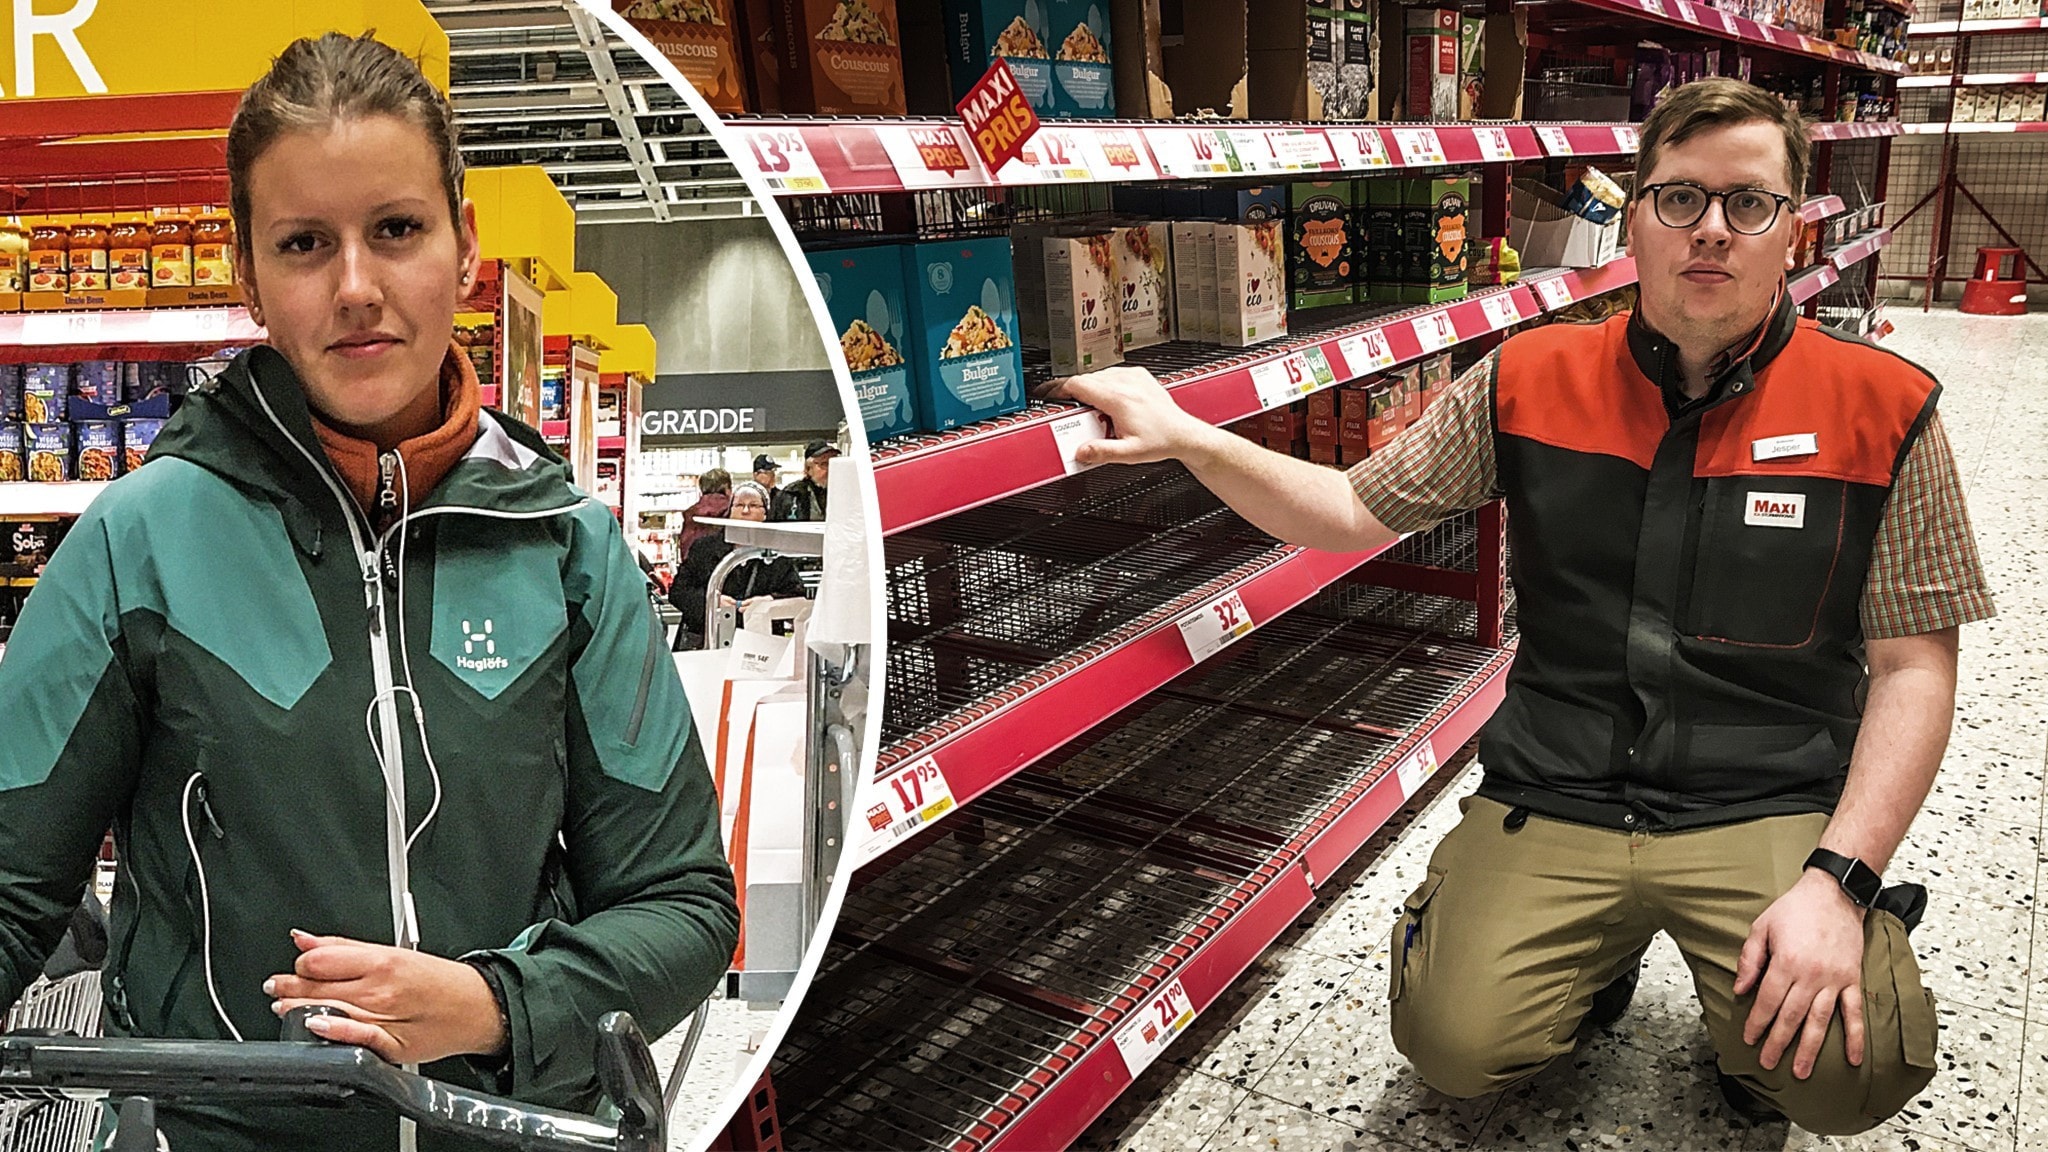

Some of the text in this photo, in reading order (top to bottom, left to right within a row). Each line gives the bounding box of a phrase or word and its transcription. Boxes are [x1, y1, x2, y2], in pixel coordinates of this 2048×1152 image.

[959, 12, 971, 63] Bulgur
[0, 0, 109, 98] R
[649, 38, 718, 58] ouscous
[830, 54, 890, 73] Couscous
[1072, 67, 1101, 81] Bulgur
[962, 66, 1014, 133] MAXI
[910, 128, 955, 146] MAXI
[976, 95, 1032, 164] PRIS
[920, 147, 964, 167] PRIS
[1106, 145, 1137, 163] PRIS
[1309, 234, 1340, 247] COUSCOUS
[1122, 299, 1138, 313] eco
[1246, 294, 1262, 307] eco
[1081, 316, 1098, 331] eco
[962, 365, 1000, 383] Bulgur
[641, 408, 754, 434] GRÄDDE
[1771, 444, 1801, 454] Jesper
[1754, 500, 1796, 514] MAXI
[12, 532, 45, 552] Soba
[456, 656, 509, 672] Haglöfs
